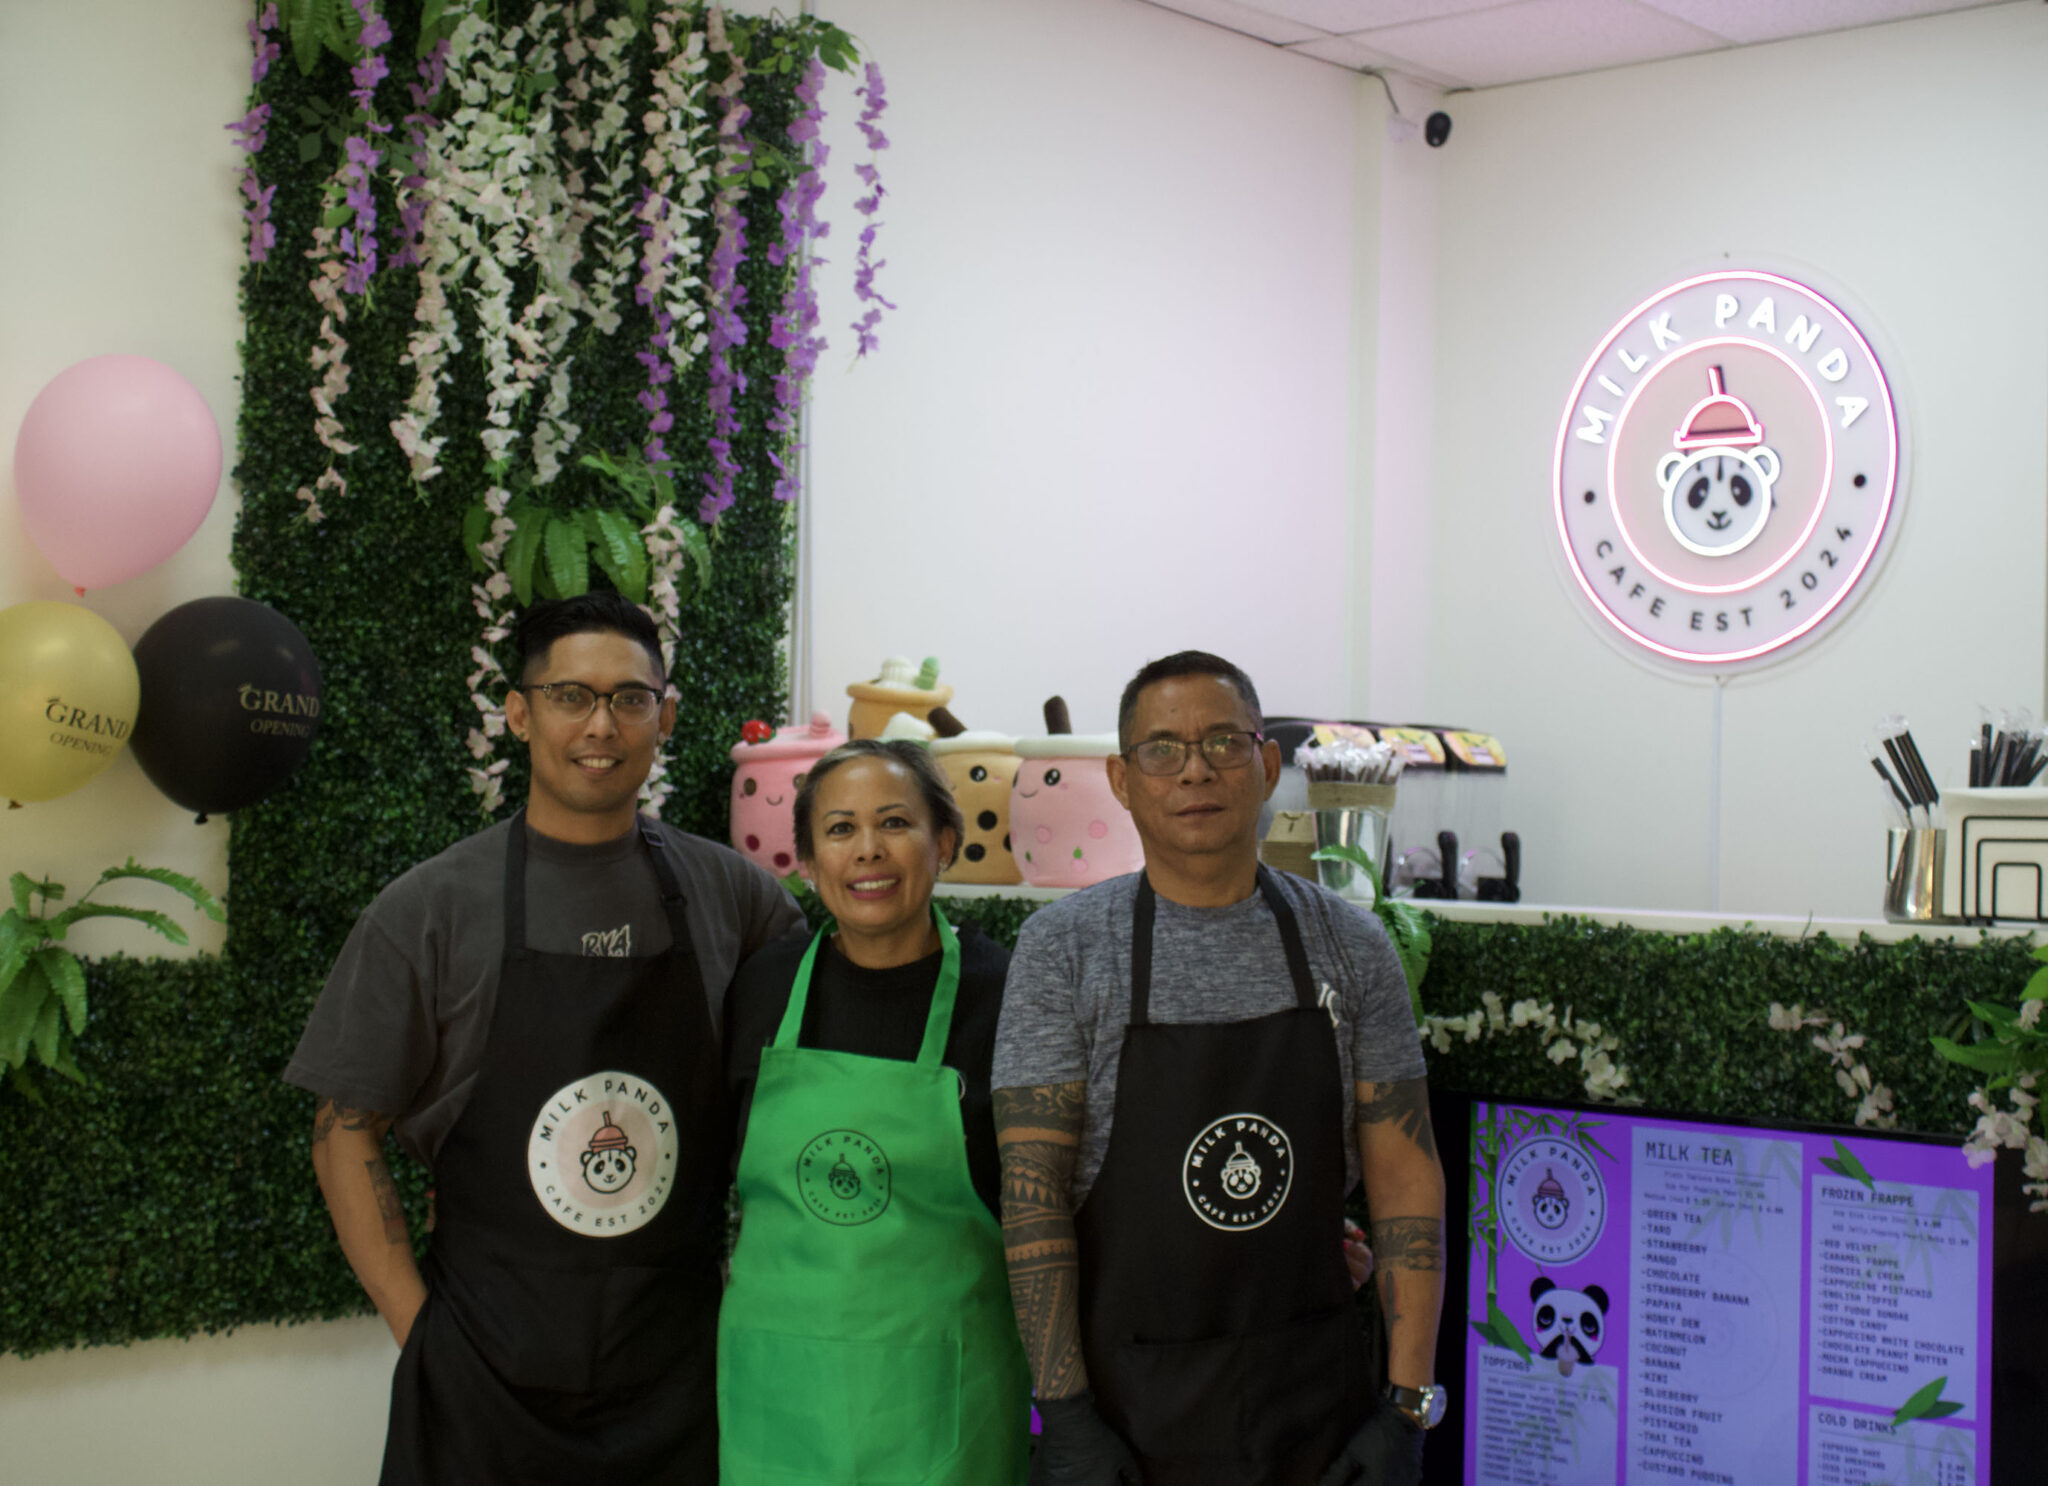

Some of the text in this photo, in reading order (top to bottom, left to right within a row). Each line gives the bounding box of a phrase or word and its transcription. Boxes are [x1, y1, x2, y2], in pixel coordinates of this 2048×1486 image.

[1576, 293, 1869, 443] MILK PANDA
[1596, 526, 1851, 631] CAFE EST 2024
[239, 688, 320, 718] GRAND
[46, 701, 129, 739] GRAND
[251, 719, 311, 738] OPENING
[540, 1080, 669, 1141] MILK PANDA
[1192, 1121, 1285, 1168] MILK PANDA
[1646, 1142, 1733, 1166] MILK TEA
[1507, 1147, 1595, 1196] MILK PANDA
[546, 1186, 583, 1222] CAFE
[595, 1215, 627, 1227] EST
[1198, 1195, 1226, 1220] CAFE
[1233, 1211, 1256, 1222] EST
[1822, 1187, 1913, 1207] FROZEN FRAPPE
[1683, 1213, 1702, 1224] TEA
[1713, 1292, 1749, 1306] BANANA
[1692, 1410, 1722, 1423] FRUIT
[1818, 1413, 1896, 1435] COLD DRINKS
[1674, 1436, 1691, 1448] TEA
